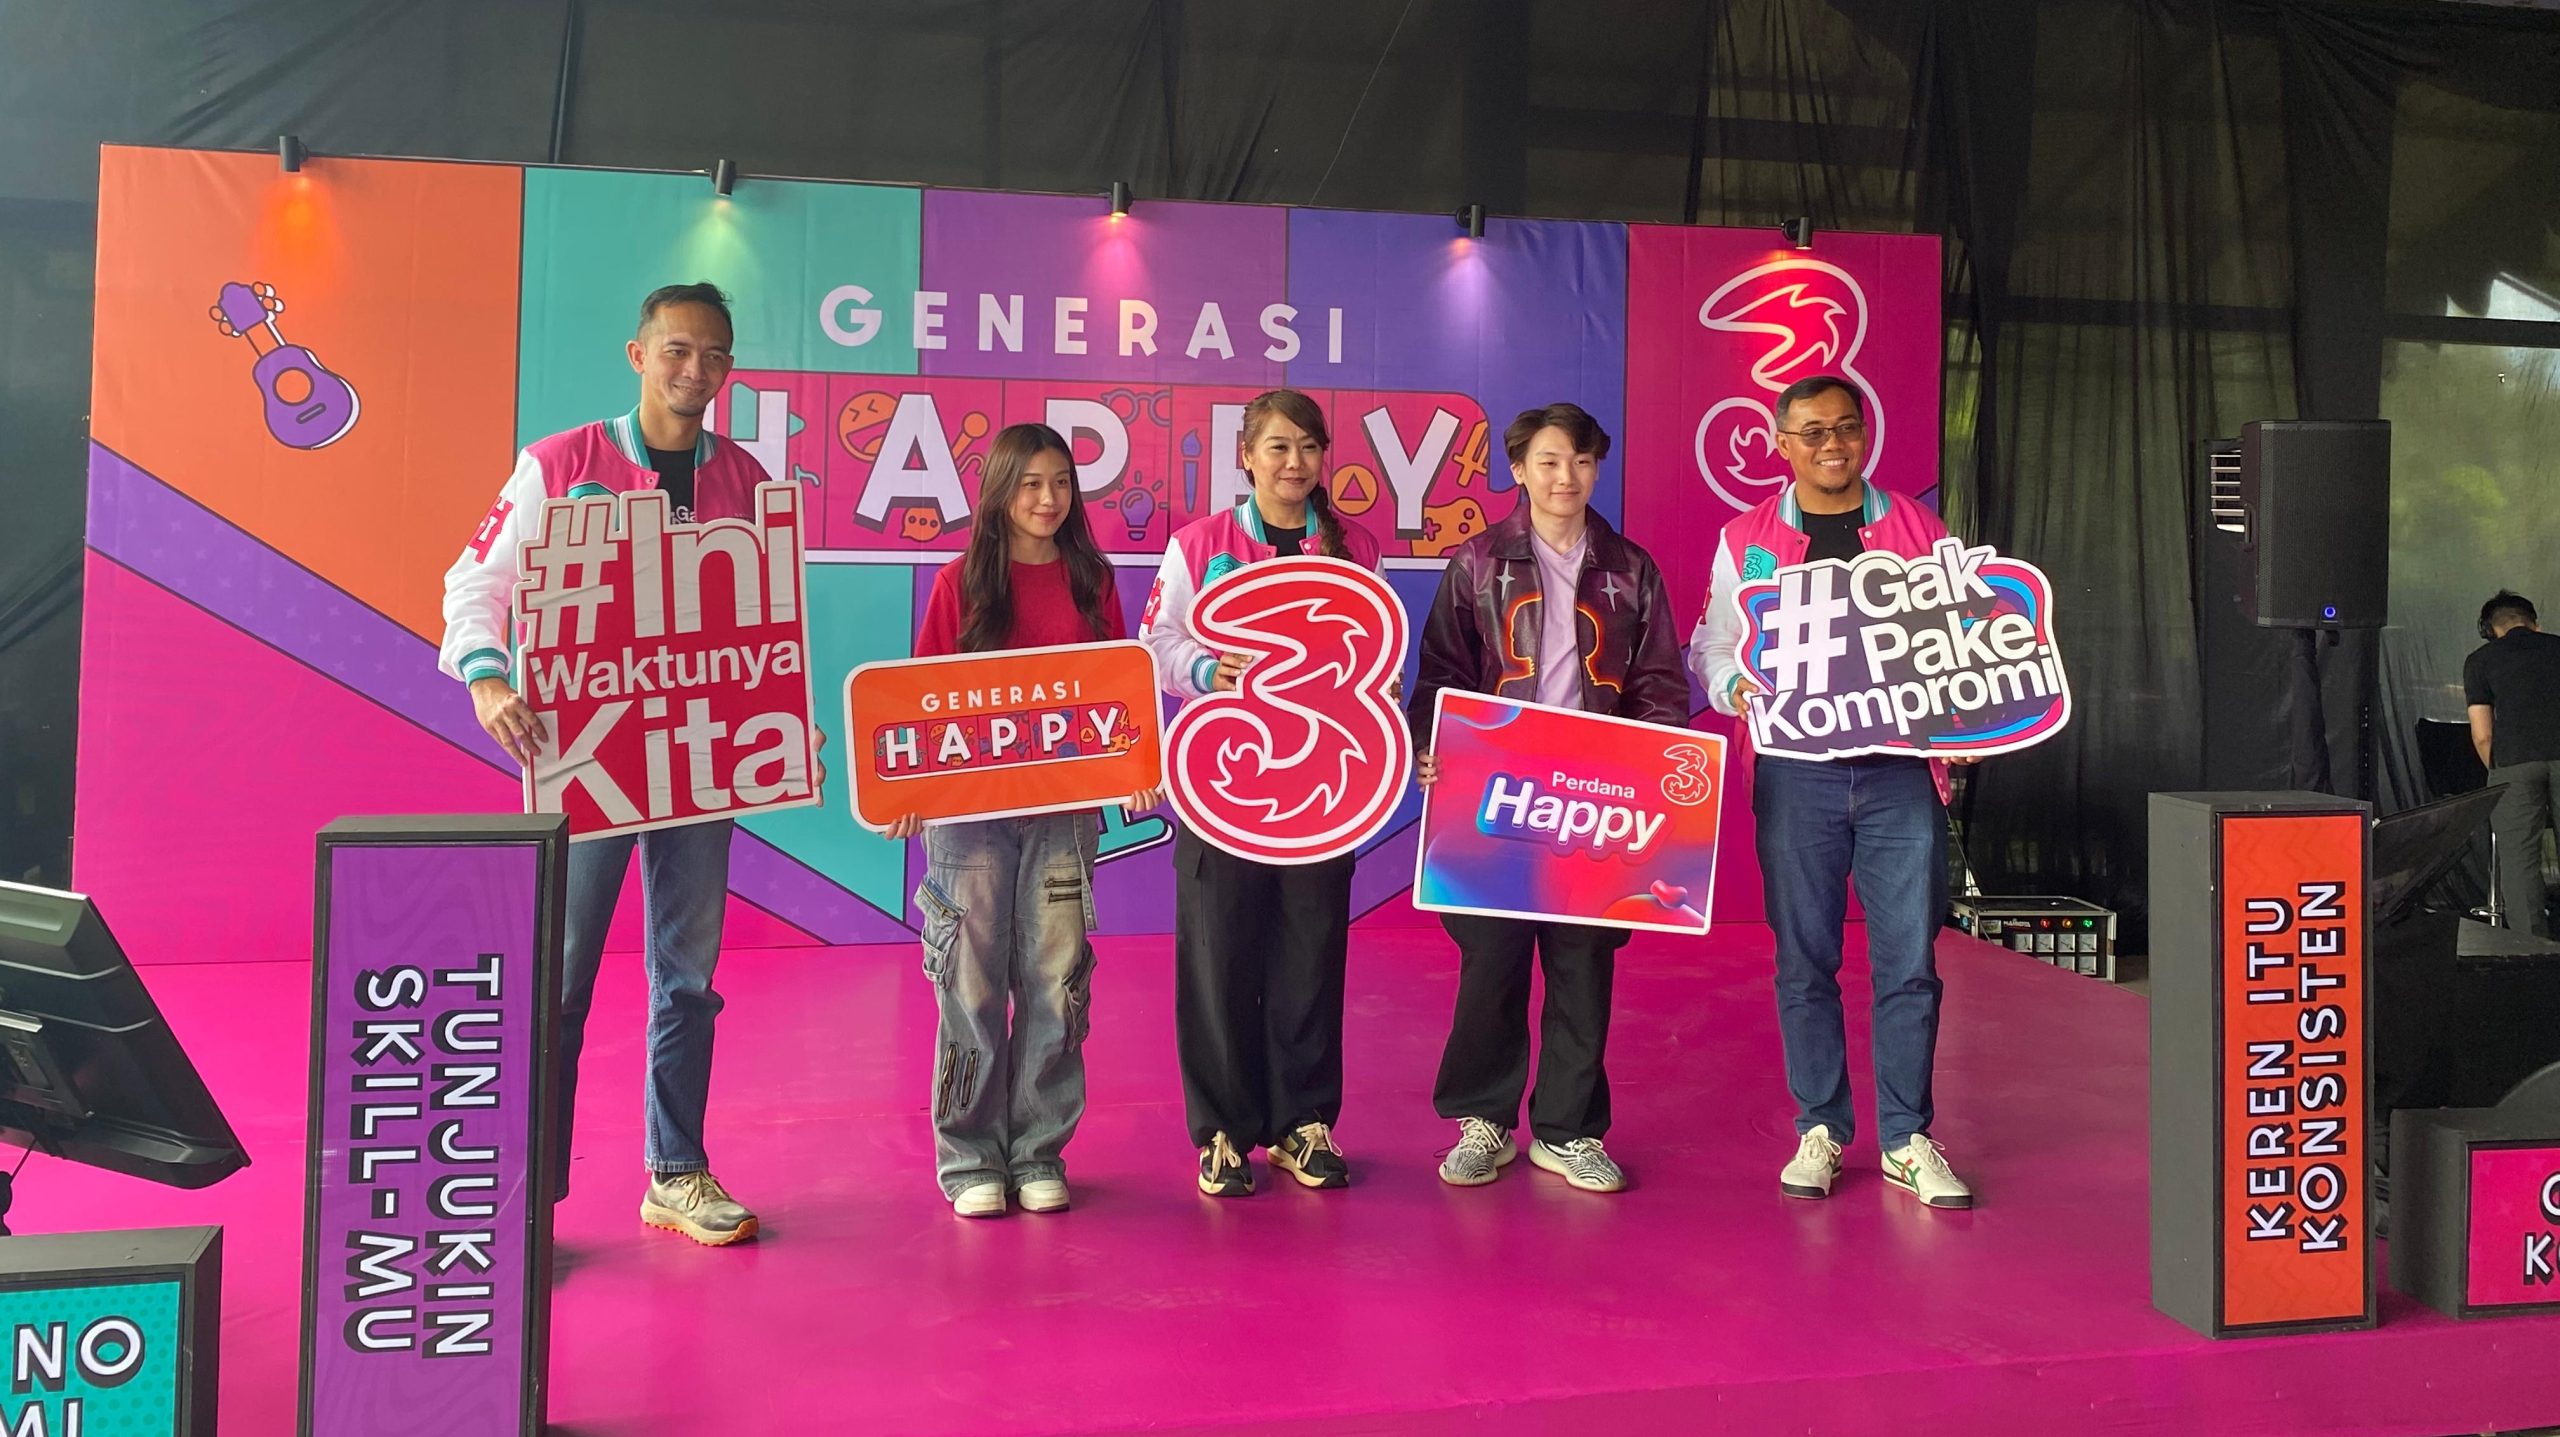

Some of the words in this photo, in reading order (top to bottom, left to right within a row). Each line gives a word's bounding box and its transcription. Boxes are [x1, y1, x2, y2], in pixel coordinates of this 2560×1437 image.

[819, 285, 1343, 365] GENERASI
[702, 390, 1462, 534] APY
[524, 488, 798, 649] #Ini
[1759, 543, 1997, 696] #Gak
[529, 639, 802, 704] Waktunya
[920, 680, 1082, 713] GENERASI
[1751, 644, 2063, 746] Kompromi
[1859, 609, 2038, 685] Pake
[533, 696, 811, 826] Kita
[884, 706, 1120, 769] HAPPY
[1551, 770, 1636, 800] Perdana
[1483, 776, 1667, 854] Happy
[2247, 900, 2290, 1003] ITU
[2300, 884, 2343, 1251] KONSISTEN
[351, 966, 426, 1352] SKILL-MU
[429, 955, 502, 1355] TUNJUKIN
[2248, 1042, 2290, 1239] KEREN
